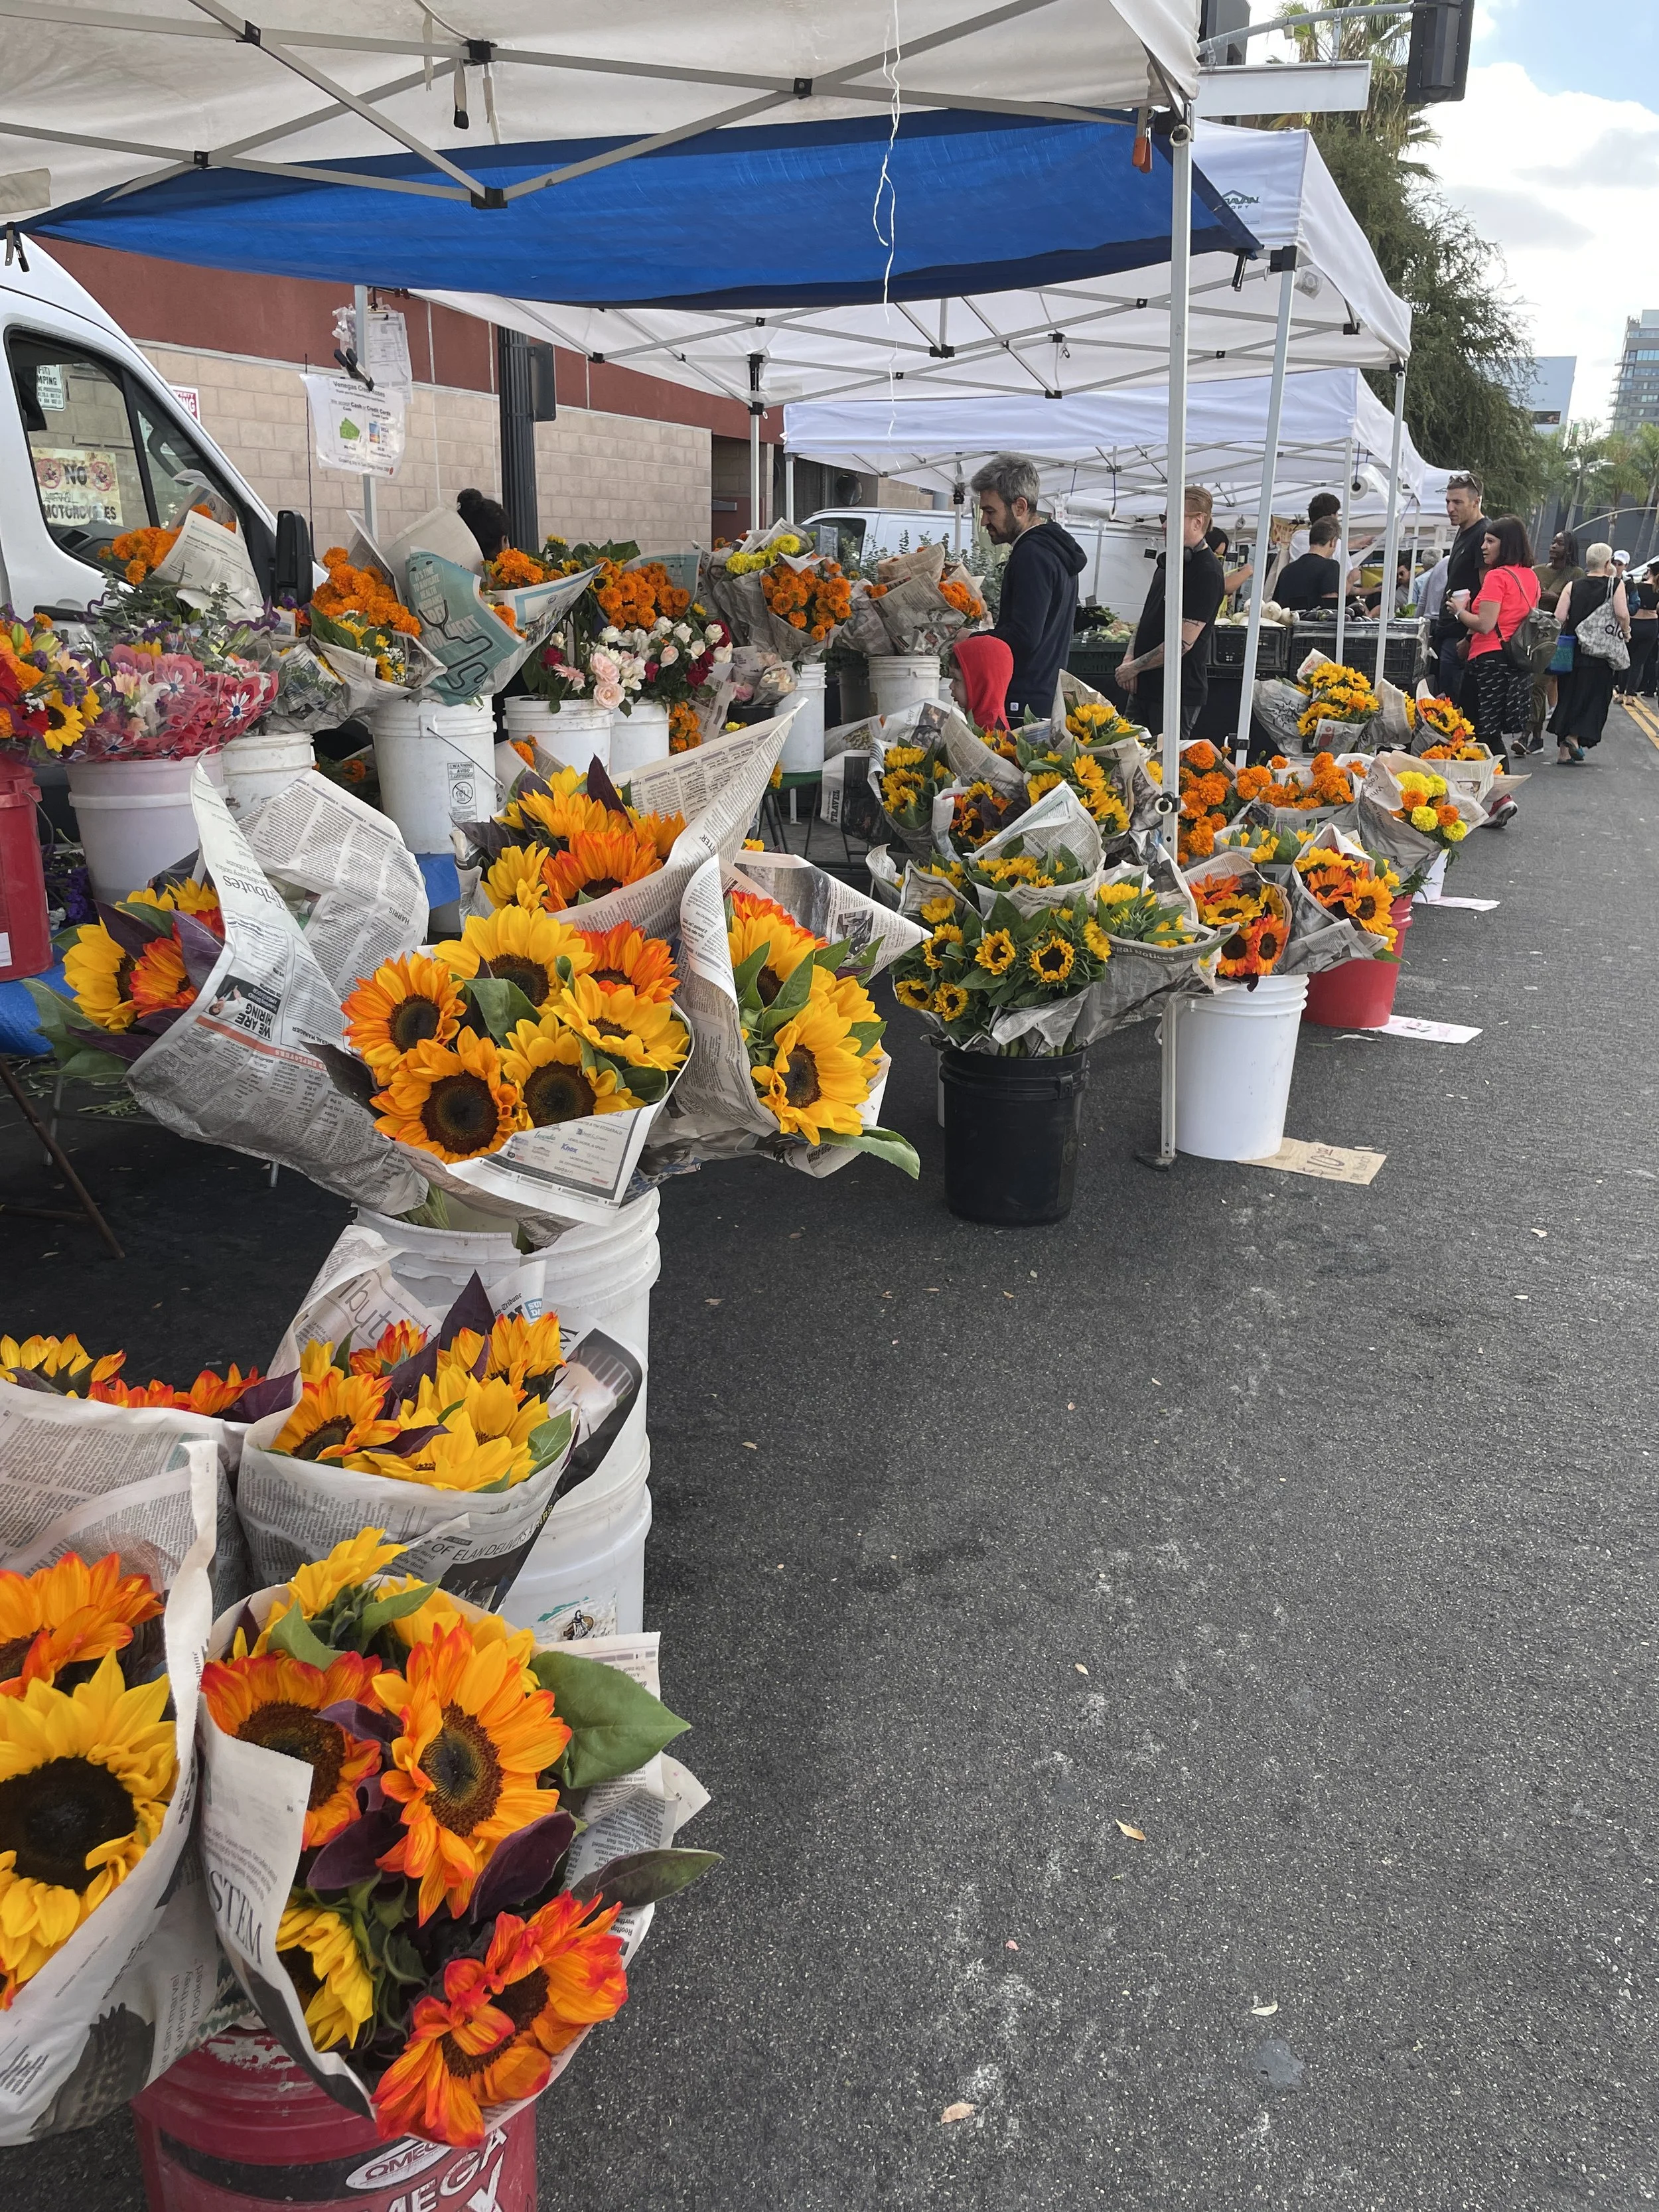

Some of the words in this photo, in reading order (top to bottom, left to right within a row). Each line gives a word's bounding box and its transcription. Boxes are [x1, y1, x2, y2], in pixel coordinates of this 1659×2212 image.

[332, 381, 357, 391] Venegas
[64, 465, 87, 485] NO
[831, 790, 841, 823] TRAVEL
[222, 875, 285, 911] Tributes
[388, 907, 410, 925] HARRIS
[1110, 944, 1133, 954] egal
[1135, 950, 1175, 962] Notices
[234, 1012, 258, 1031] ARE
[244, 1003, 273, 1026] HIRING
[258, 1023, 270, 1039] WE
[291, 1026, 315, 1041] MANAGER
[275, 1049, 317, 1067] EMPLOYERS
[561, 1143, 579, 1154] Knox
[338, 1272, 394, 1341] ibut
[494, 1292, 522, 1317] on-Tribune
[421, 1549, 435, 1560] Rand
[431, 1543, 455, 1556] OF
[453, 1545, 487, 1562] ELAN
[484, 1532, 528, 1556] DELIVERS
[409, 1561, 425, 1570] done
[591, 1841, 616, 1851] estimated
[608, 1832, 630, 1842] Electric's
[210, 1870, 262, 1965] STEM
[610, 1925, 633, 1937] Rooftop
[168, 1974, 180, 2024] marvel
[175, 2003, 186, 2041] when
[182, 1970, 194, 2001] they
